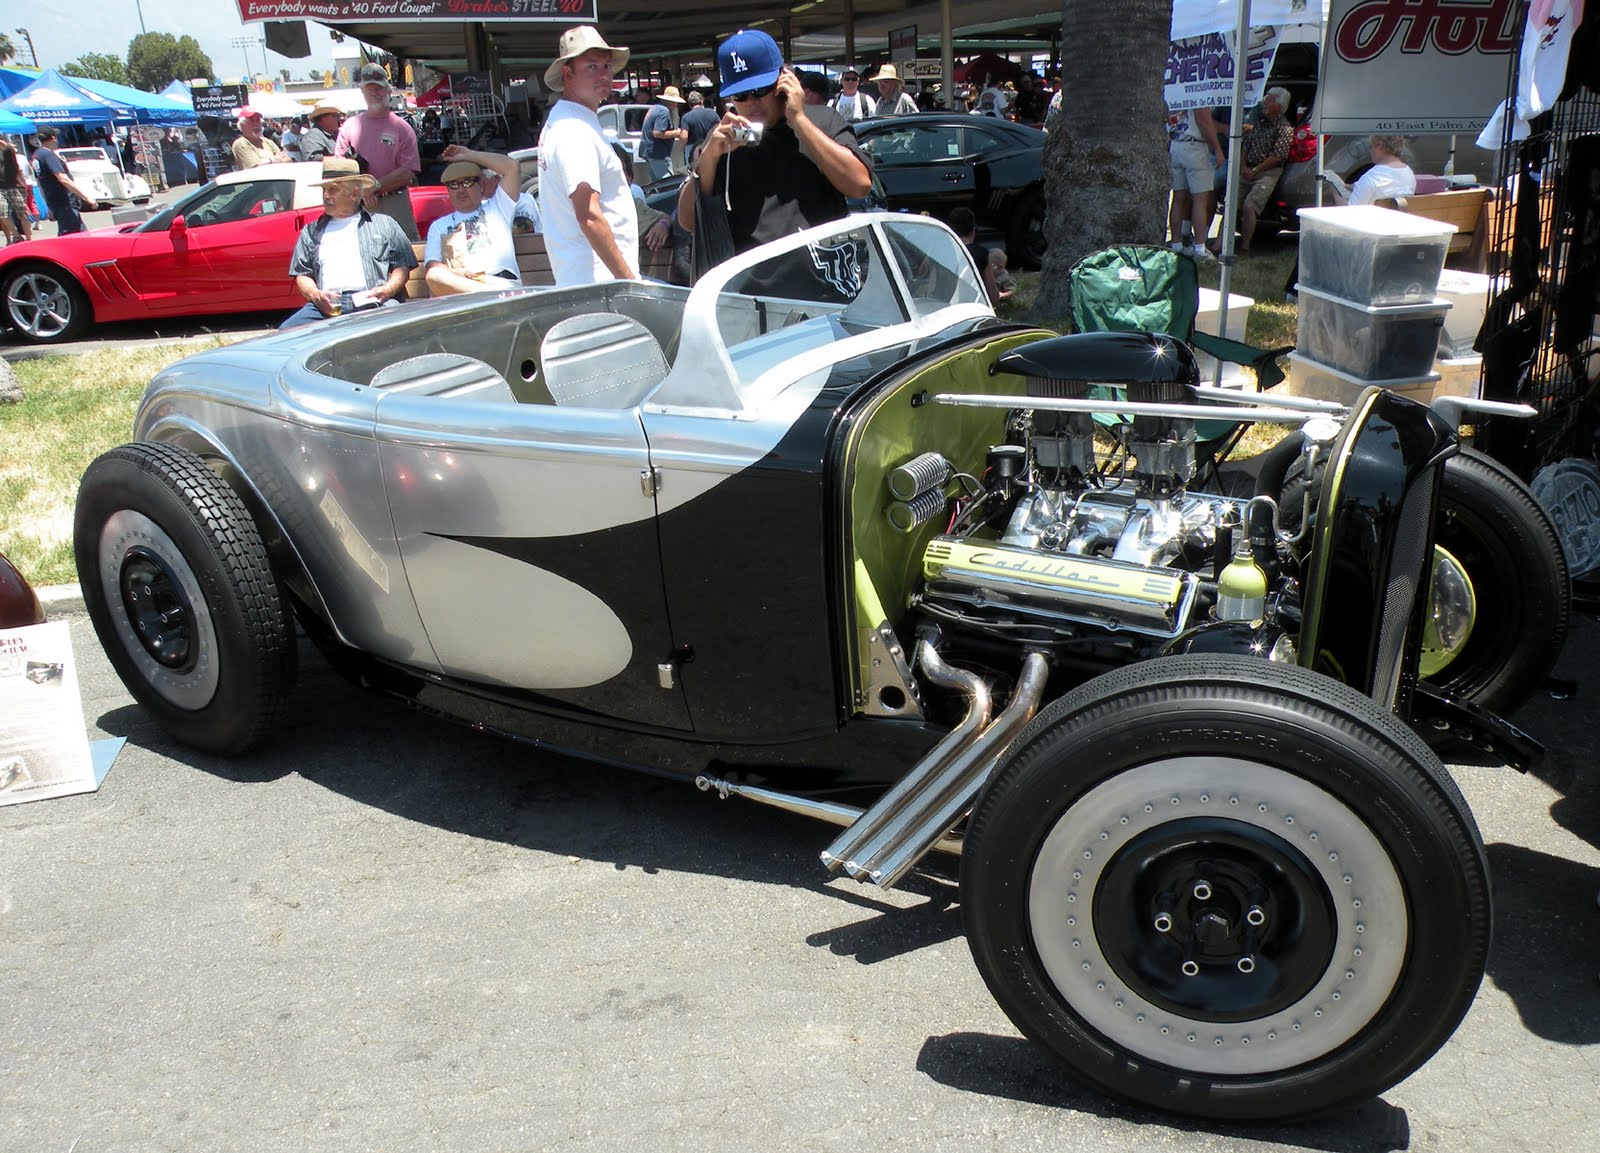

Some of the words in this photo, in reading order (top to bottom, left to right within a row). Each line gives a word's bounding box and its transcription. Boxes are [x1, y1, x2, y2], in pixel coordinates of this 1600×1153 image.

[249, 1, 305, 15] Everybody
[309, 3, 338, 15] wants
[342, 5, 349, 14] a
[351, 3, 369, 14] '40
[372, 2, 396, 14] Ford
[512, 0, 558, 12] STEEL
[730, 51, 748, 73] LA
[1163, 48, 1276, 85] CHEVROET
[1430, 121, 1463, 129] Palm
[969, 552, 1119, 588] Cadillac
